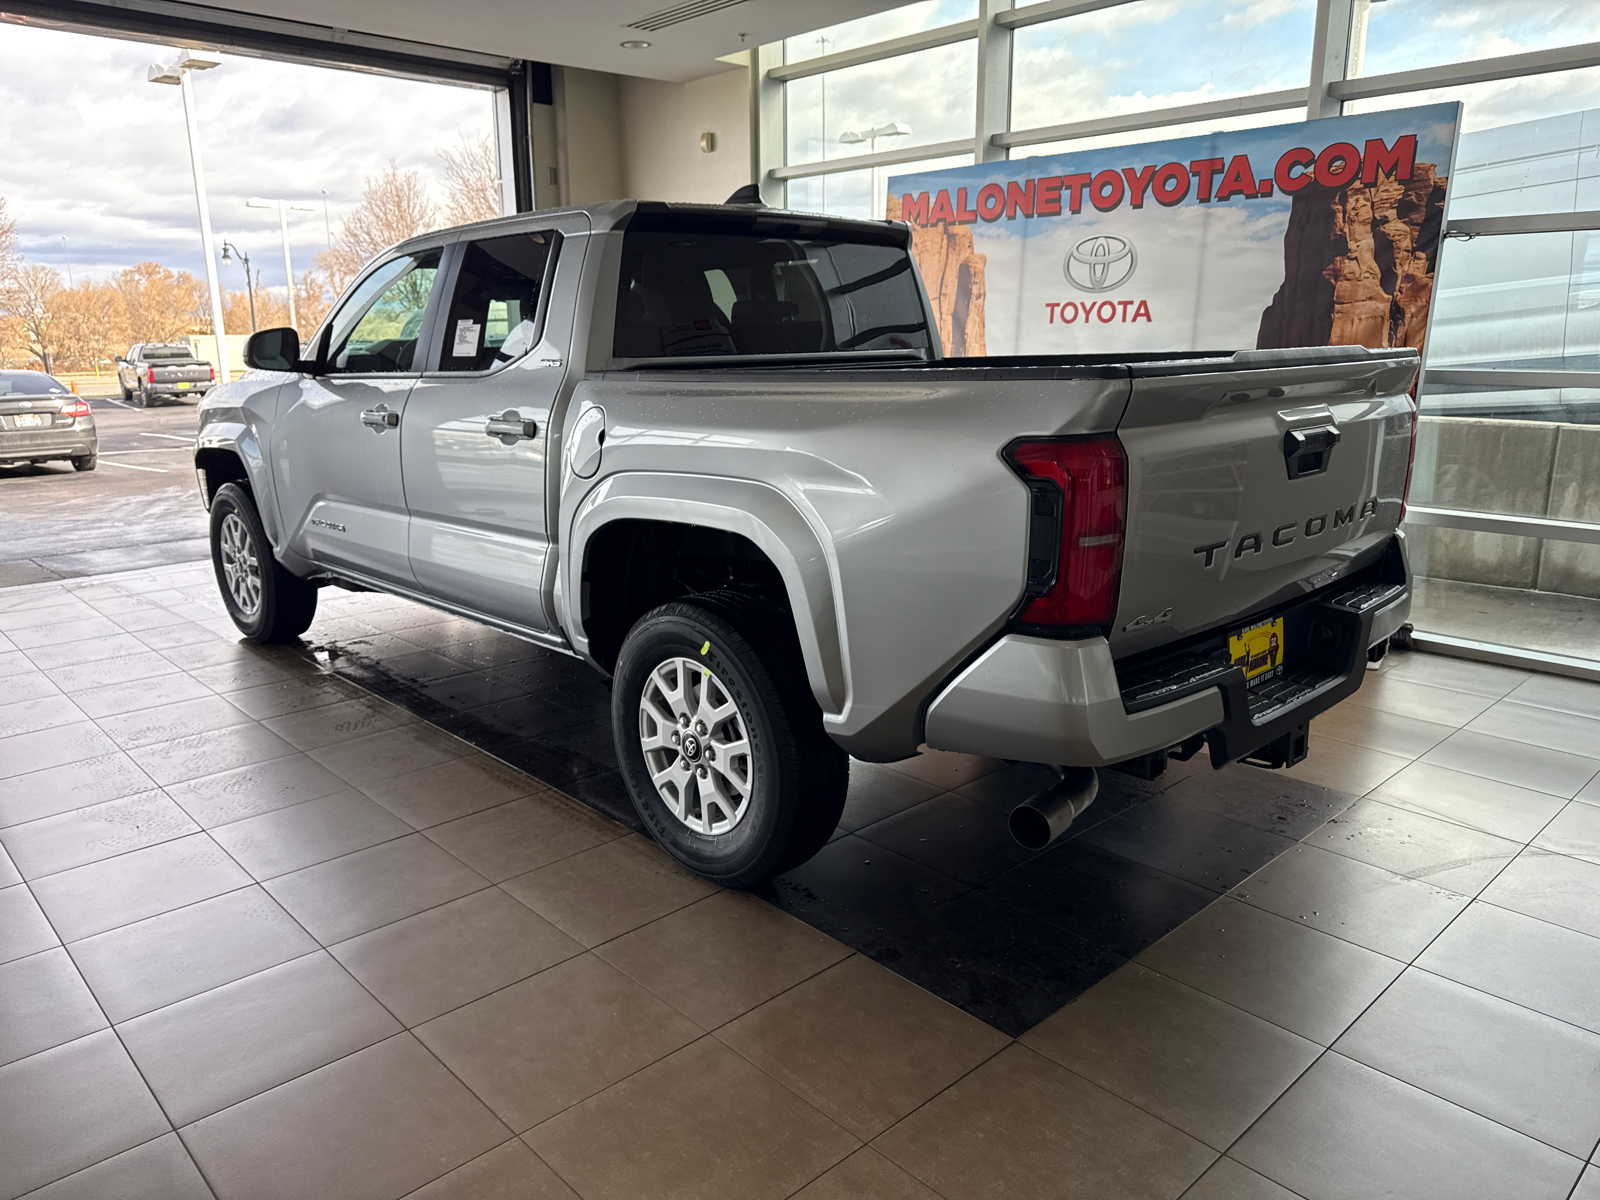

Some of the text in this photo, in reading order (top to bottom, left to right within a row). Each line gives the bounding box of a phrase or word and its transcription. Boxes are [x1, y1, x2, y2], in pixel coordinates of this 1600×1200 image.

[901, 134, 1417, 227] MALONETOYOTA.COM
[1045, 300, 1152, 324] TOYOTA
[1193, 496, 1377, 569] TACOMA
[1270, 637, 1277, 647] 32
